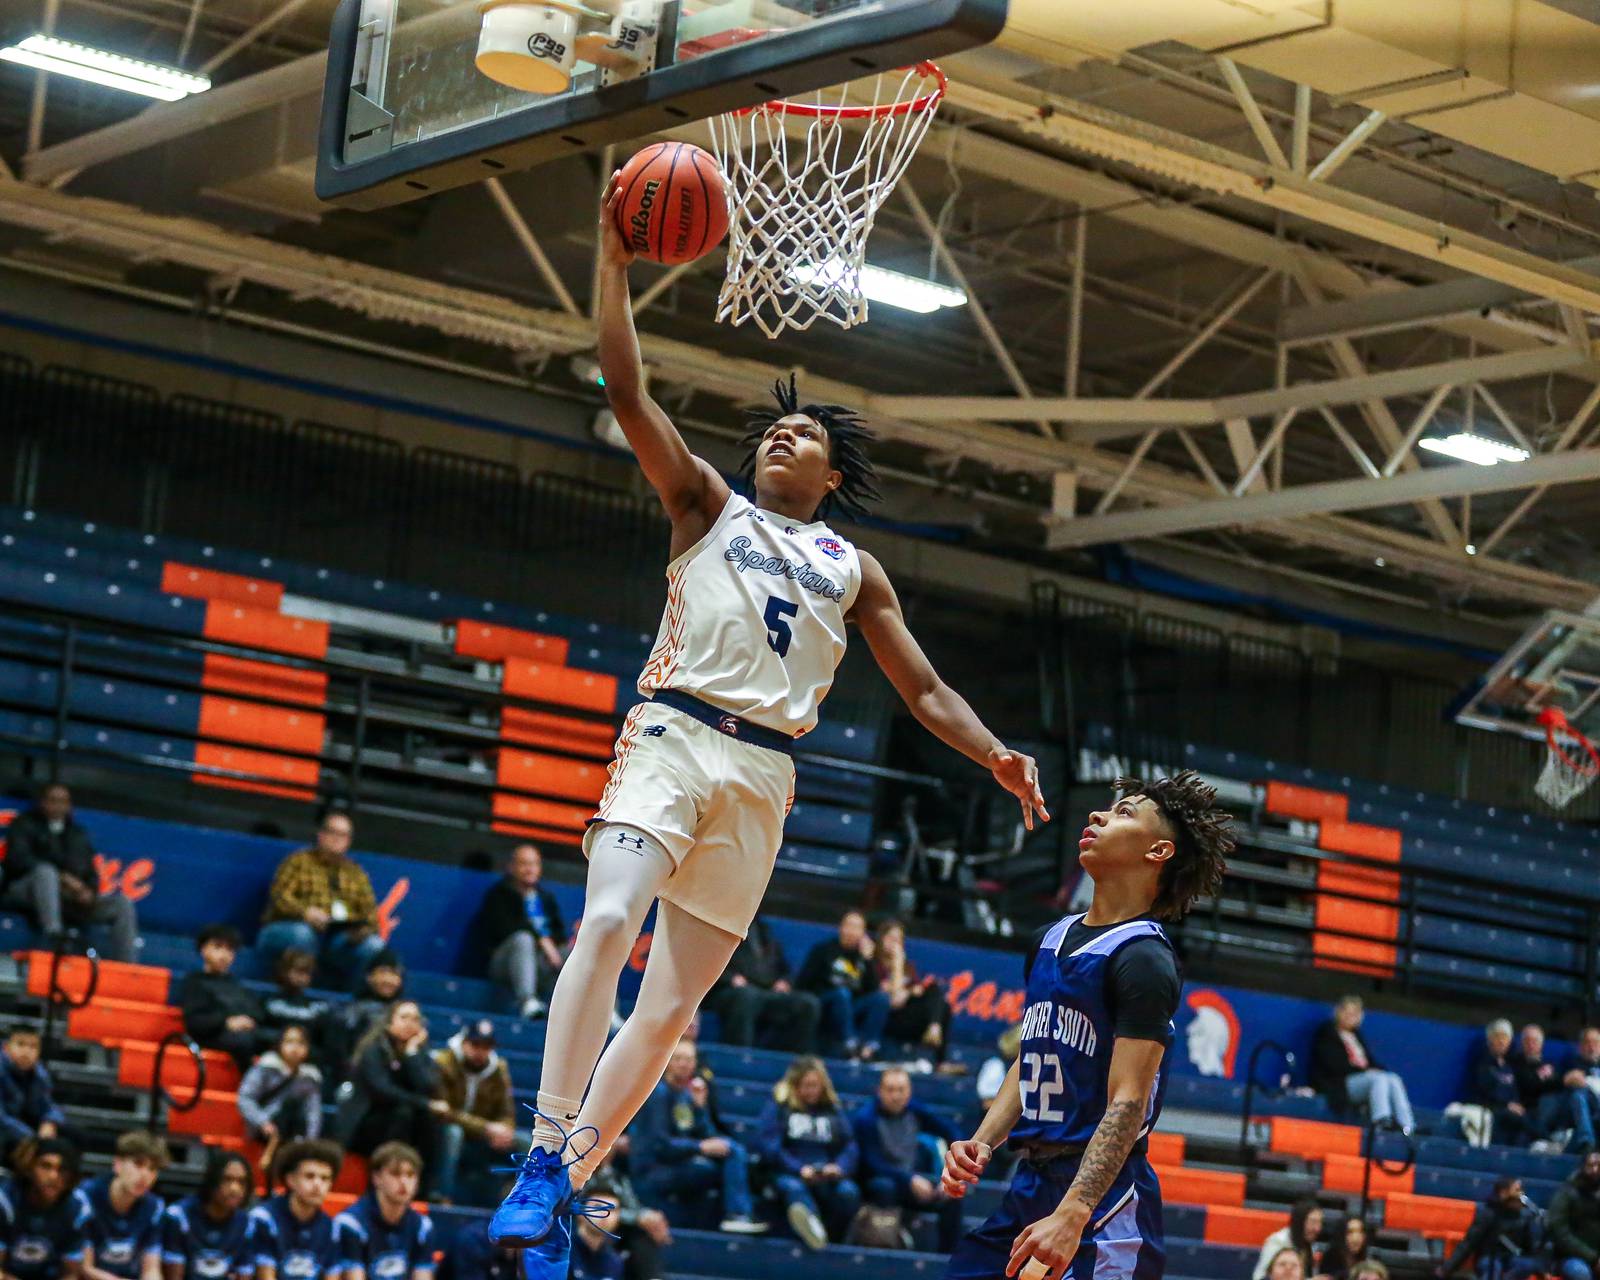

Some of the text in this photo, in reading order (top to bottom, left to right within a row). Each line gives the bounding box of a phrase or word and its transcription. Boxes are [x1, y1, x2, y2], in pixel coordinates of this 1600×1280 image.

[630, 179, 661, 253] Wilson
[724, 536, 845, 603] Spartans
[763, 595, 799, 659] 5
[1053, 1005, 1097, 1057] SOUTH
[1019, 1052, 1064, 1122] 22
